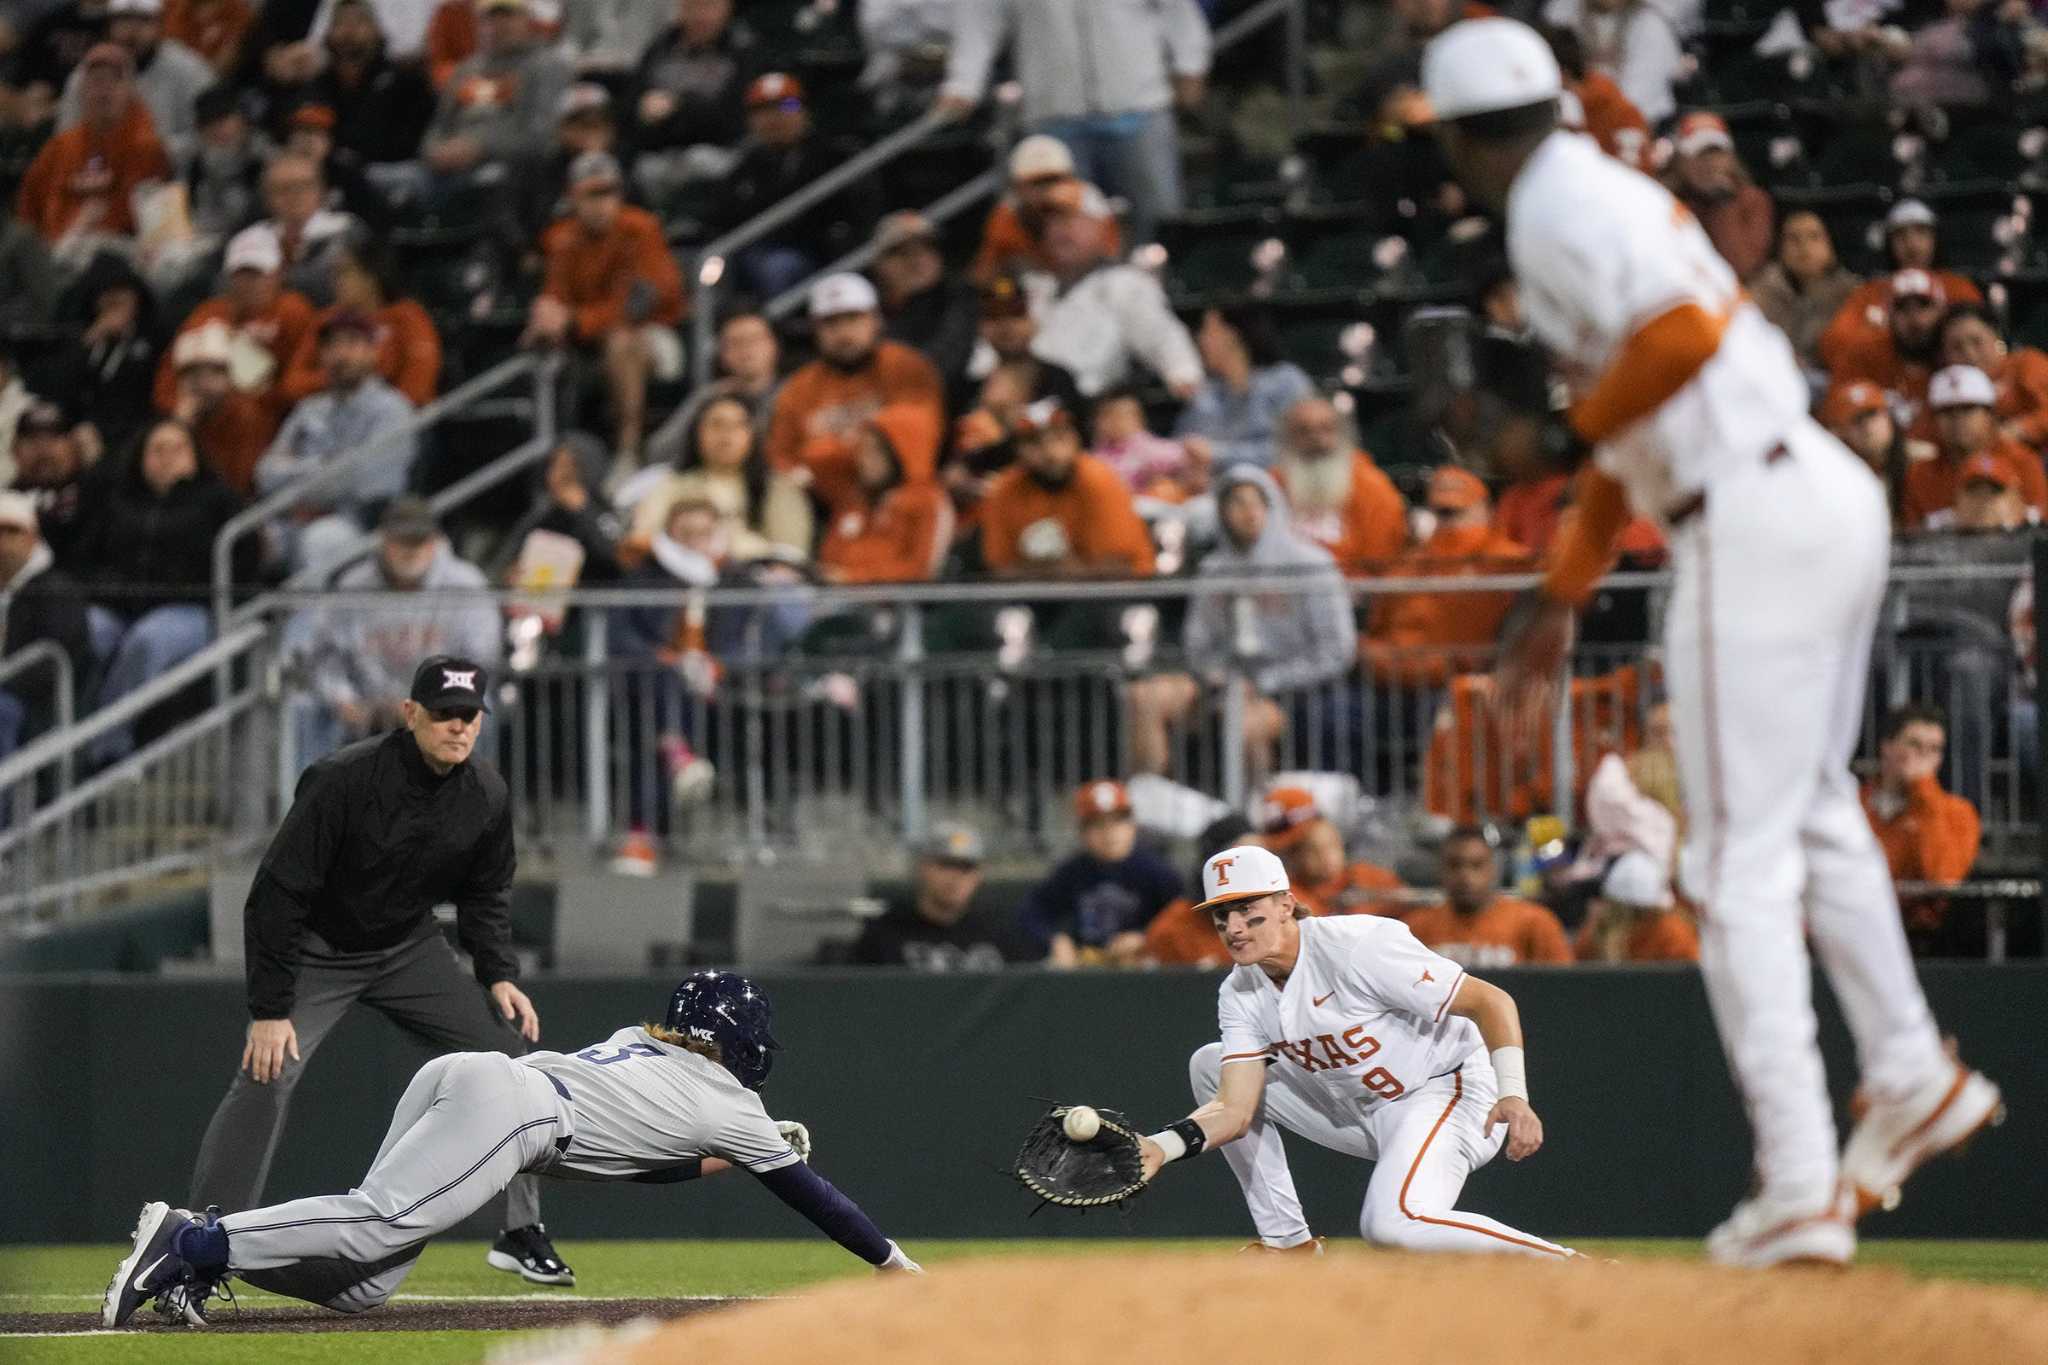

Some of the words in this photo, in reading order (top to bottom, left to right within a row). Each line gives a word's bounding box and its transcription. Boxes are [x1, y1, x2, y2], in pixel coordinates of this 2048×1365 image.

[1212, 858, 1234, 887] T
[1268, 1025, 1381, 1073] TXAS
[1361, 1066, 1405, 1100] 9
